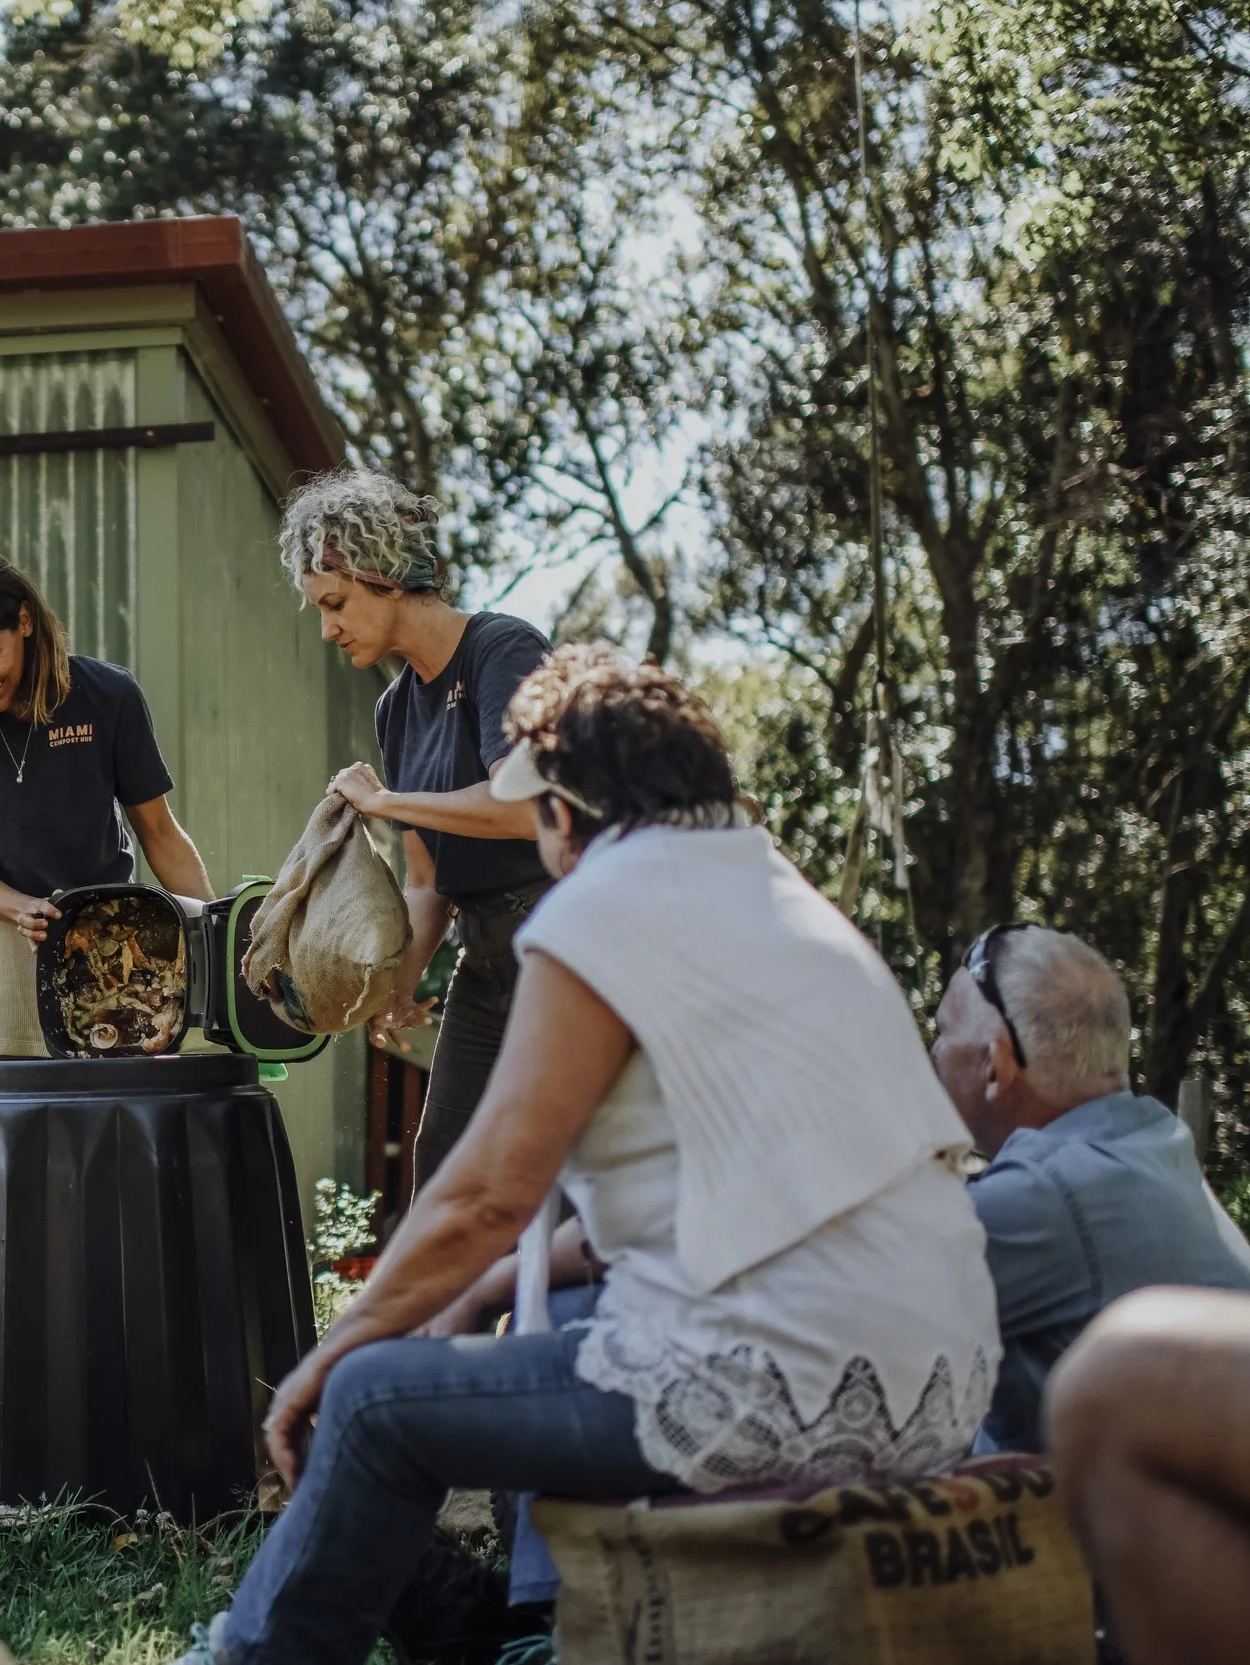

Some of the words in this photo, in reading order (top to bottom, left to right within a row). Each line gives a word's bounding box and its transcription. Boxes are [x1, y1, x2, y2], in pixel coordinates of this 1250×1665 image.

[48, 724, 92, 741] MIAMI
[49, 737, 79, 747] COMPOST
[865, 1512, 1035, 1588] BRASIL
